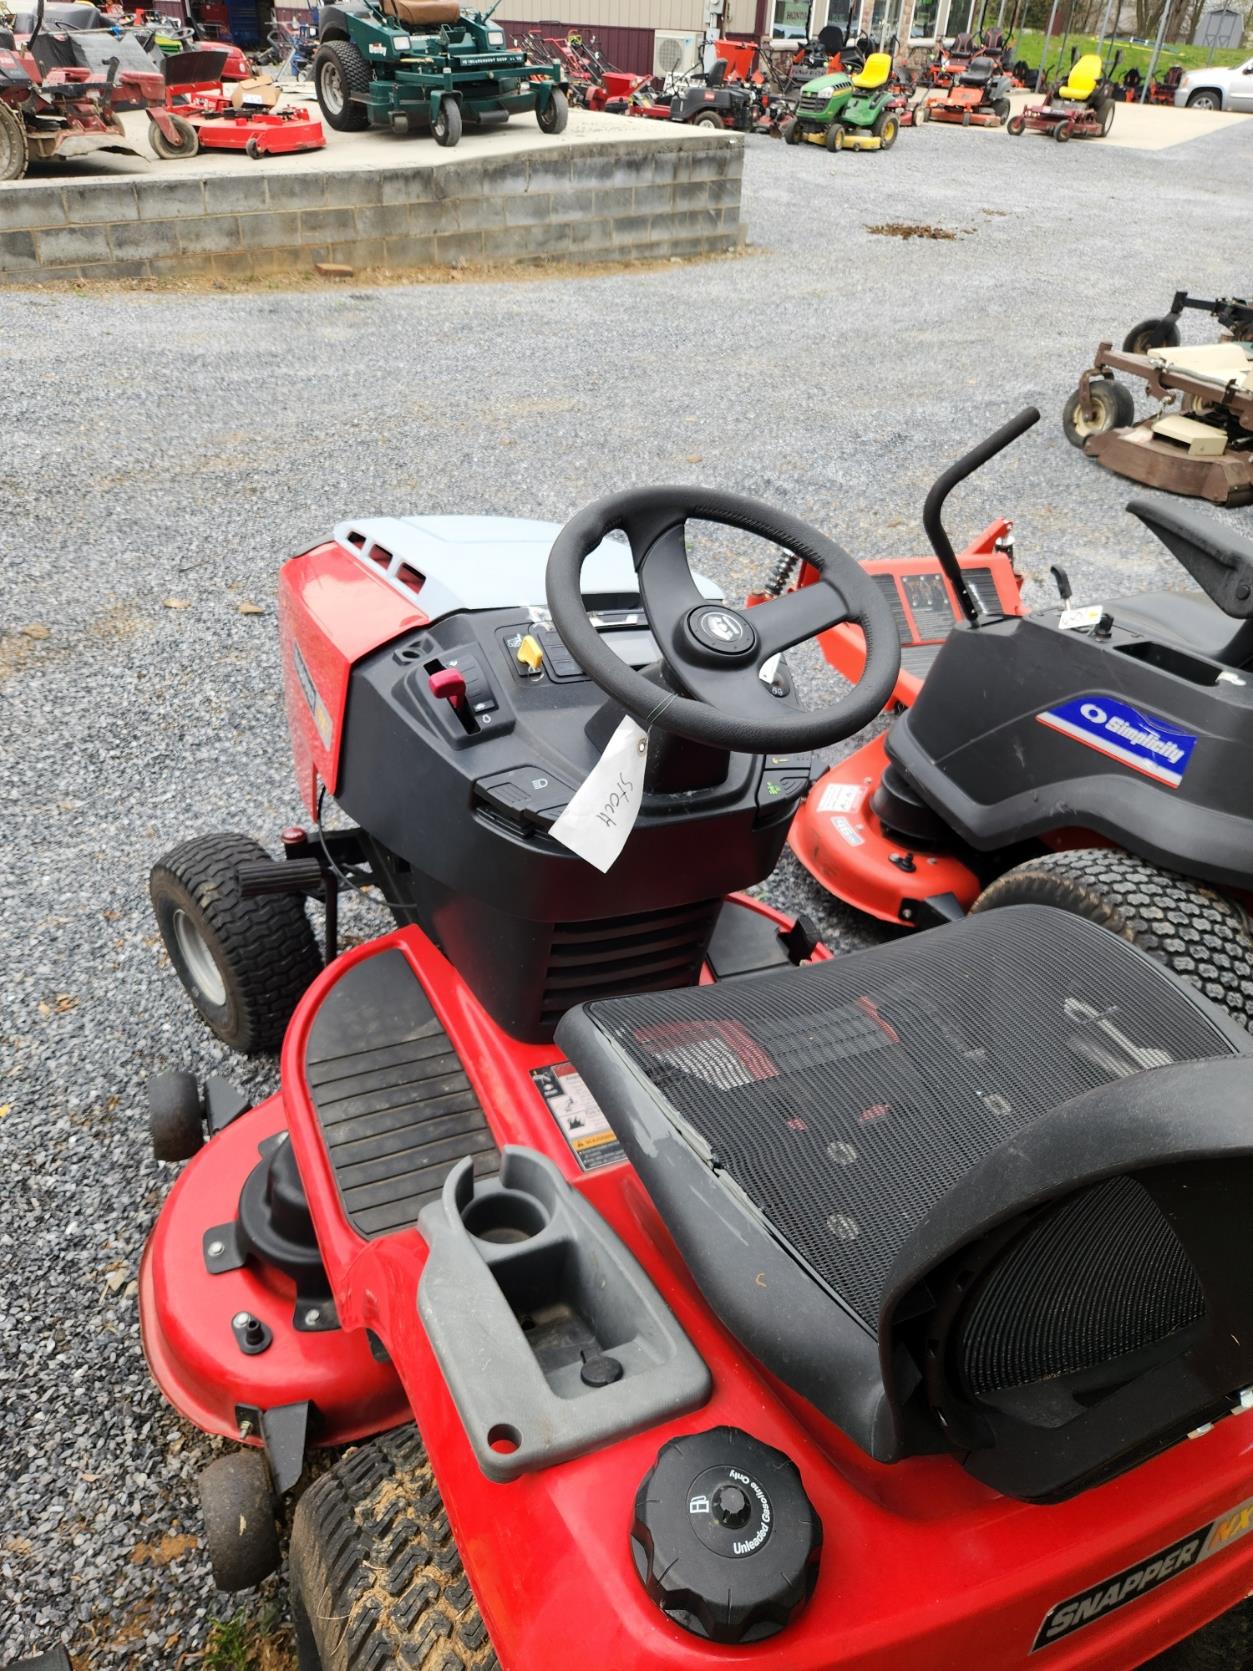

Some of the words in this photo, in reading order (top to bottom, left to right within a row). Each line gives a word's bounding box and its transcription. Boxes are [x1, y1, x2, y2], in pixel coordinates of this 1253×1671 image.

[1105, 716, 1184, 764] Simplicity
[729, 1469, 750, 1484] Only
[750, 1482, 770, 1523] Gasoline
[733, 1522, 769, 1554] Unleaded
[1046, 1539, 1199, 1638] SNAPPER
